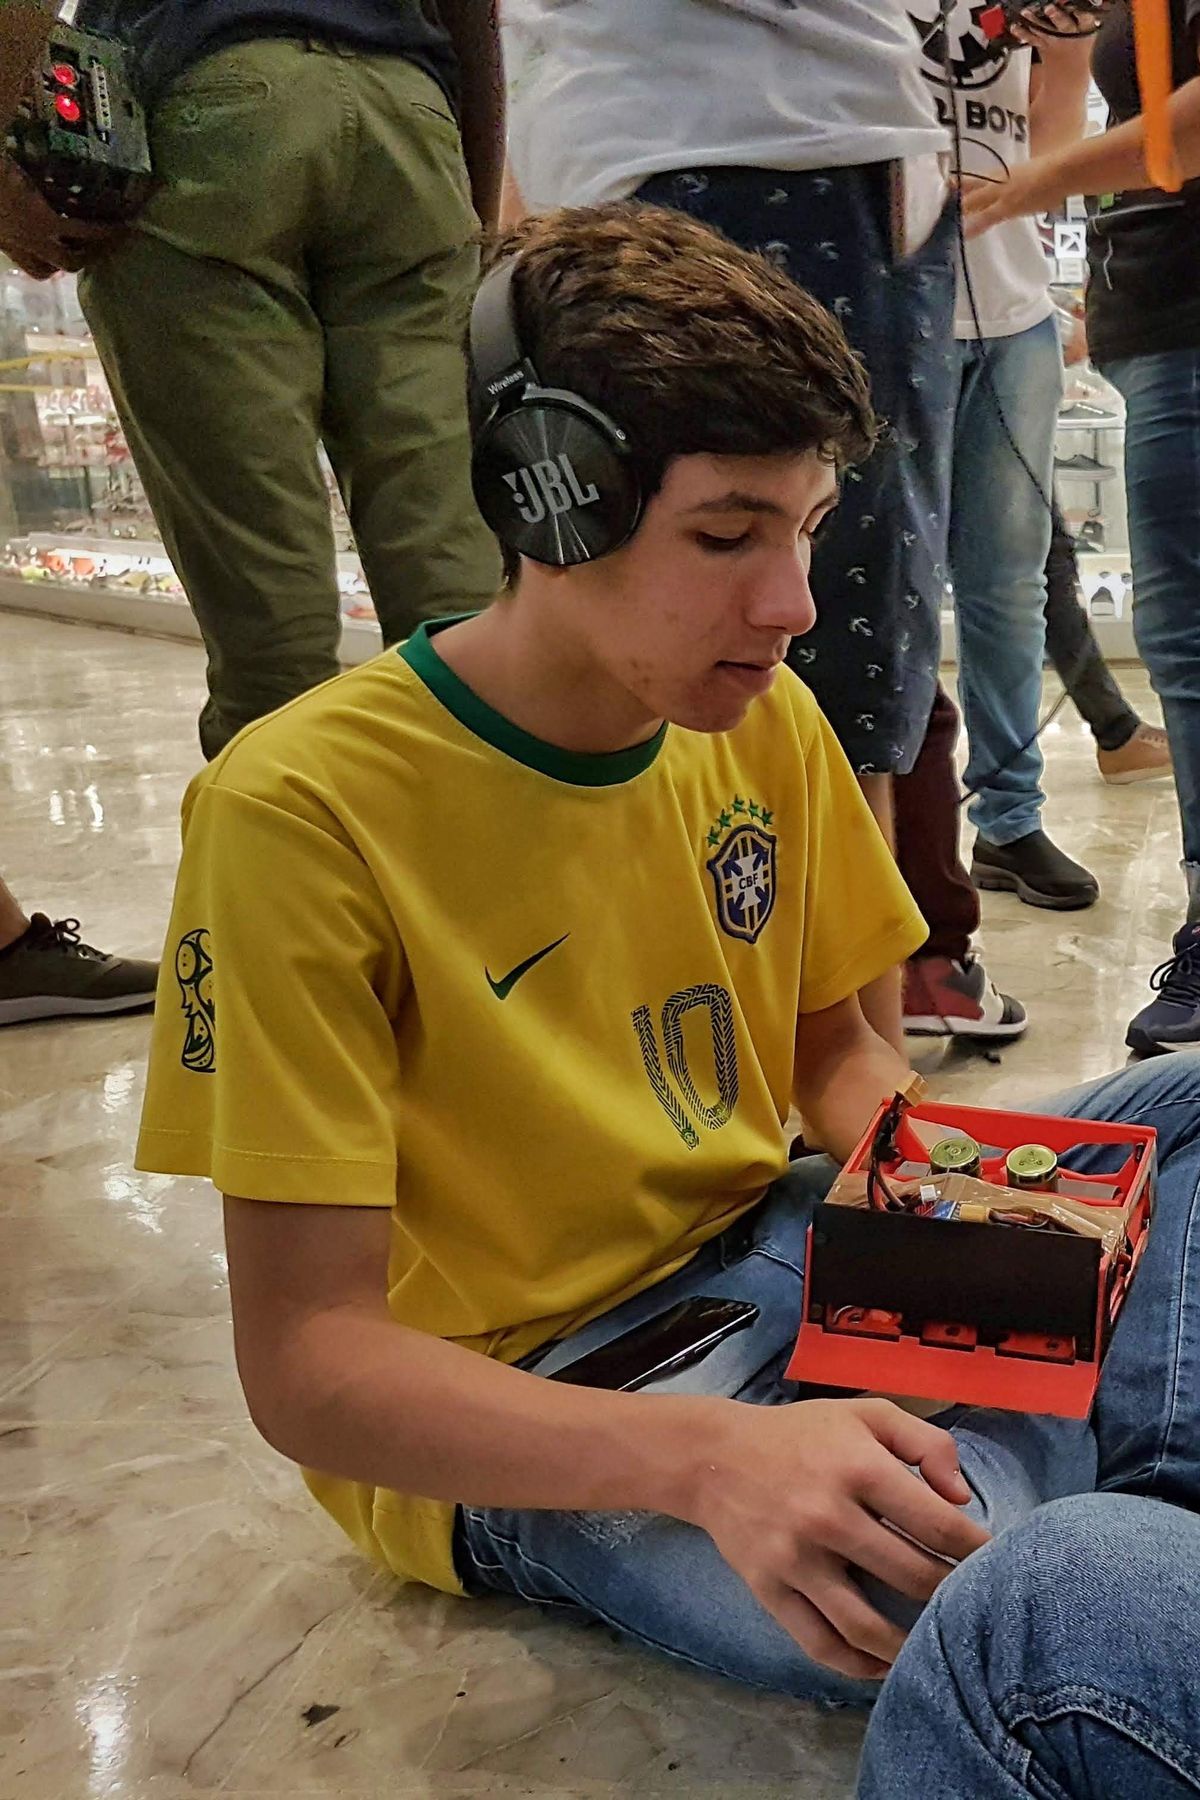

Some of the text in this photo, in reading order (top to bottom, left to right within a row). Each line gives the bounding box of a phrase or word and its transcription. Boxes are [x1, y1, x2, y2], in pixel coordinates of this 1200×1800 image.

[966, 99, 1026, 143] BOTS
[487, 370, 524, 395] Wireless
[502, 453, 600, 523] JBL
[739, 873, 758, 890] CBF
[631, 984, 739, 1150] 10
